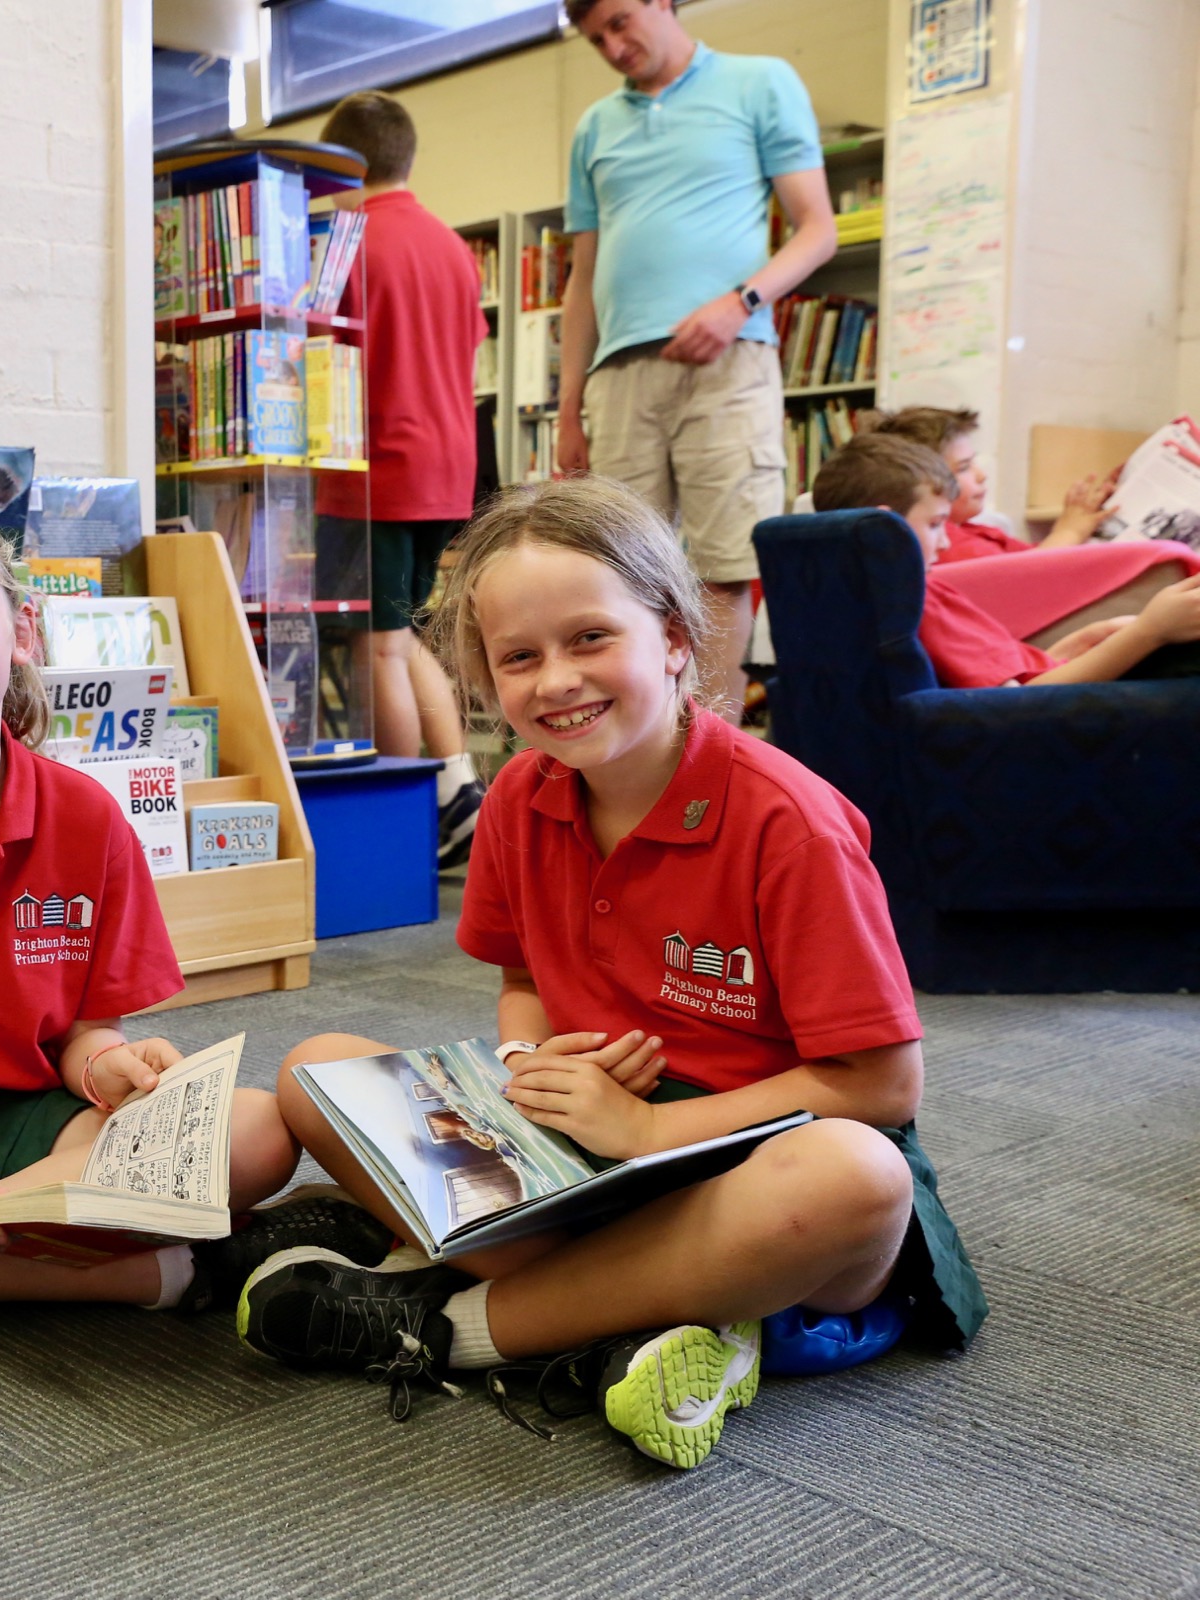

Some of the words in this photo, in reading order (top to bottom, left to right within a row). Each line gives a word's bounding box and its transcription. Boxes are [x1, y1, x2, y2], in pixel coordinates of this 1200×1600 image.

[27, 572, 89, 594] Little
[54, 681, 112, 710] LEGO
[49, 708, 140, 754] DEAS
[138, 708, 156, 749] BOOK
[133, 766, 175, 779] MOTOR
[129, 779, 176, 798] BIKE
[131, 797, 177, 815] BOOK
[197, 815, 274, 834] KICKING
[13, 937, 59, 952] Brighton
[60, 935, 91, 948] Beach
[14, 952, 56, 965] Primary
[57, 949, 89, 962] School
[663, 971, 714, 999] Brighton
[716, 988, 756, 1007] Beach
[660, 984, 708, 1012] Primary
[710, 1002, 757, 1020] School
